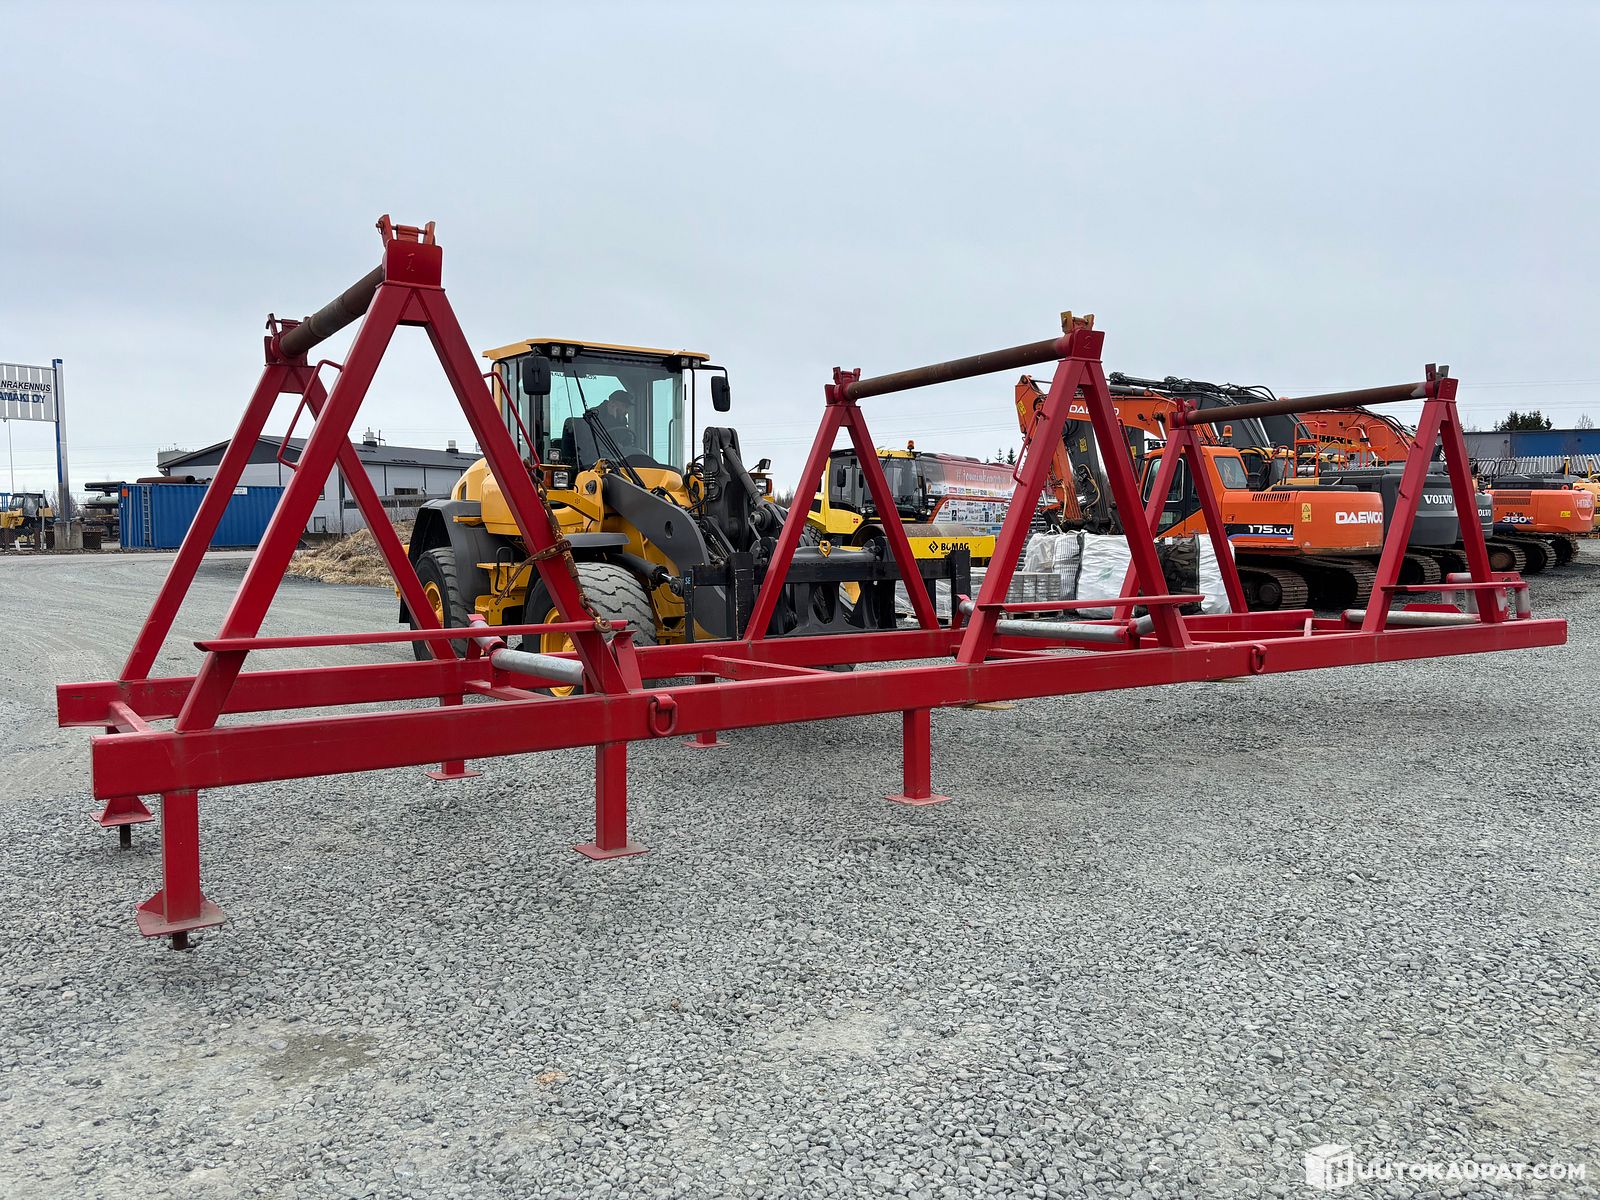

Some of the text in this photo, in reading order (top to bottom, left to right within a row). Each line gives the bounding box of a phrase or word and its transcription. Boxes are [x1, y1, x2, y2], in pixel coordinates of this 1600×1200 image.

[1423, 494, 1452, 504] VOLVO
[1335, 511, 1383, 524] DAEWOO
[1478, 509, 1491, 517] OLVO
